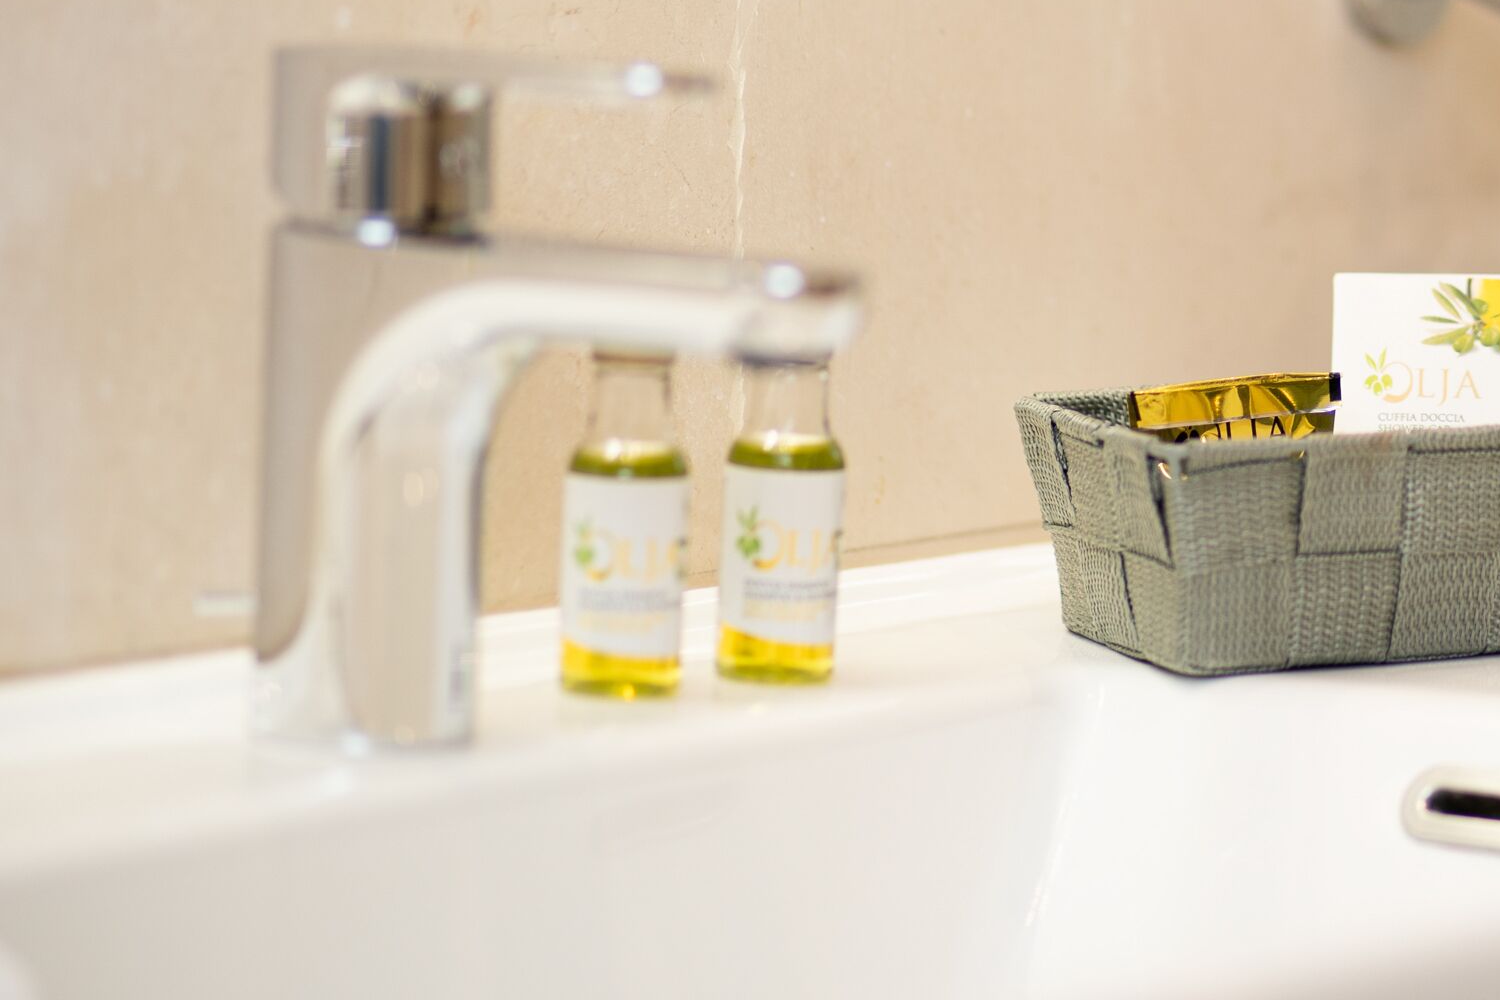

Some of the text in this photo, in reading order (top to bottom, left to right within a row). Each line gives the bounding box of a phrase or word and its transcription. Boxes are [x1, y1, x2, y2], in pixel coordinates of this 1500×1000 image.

[1381, 361, 1484, 406] OLJA
[1377, 412, 1465, 423] CUFFIA DOCCIA
